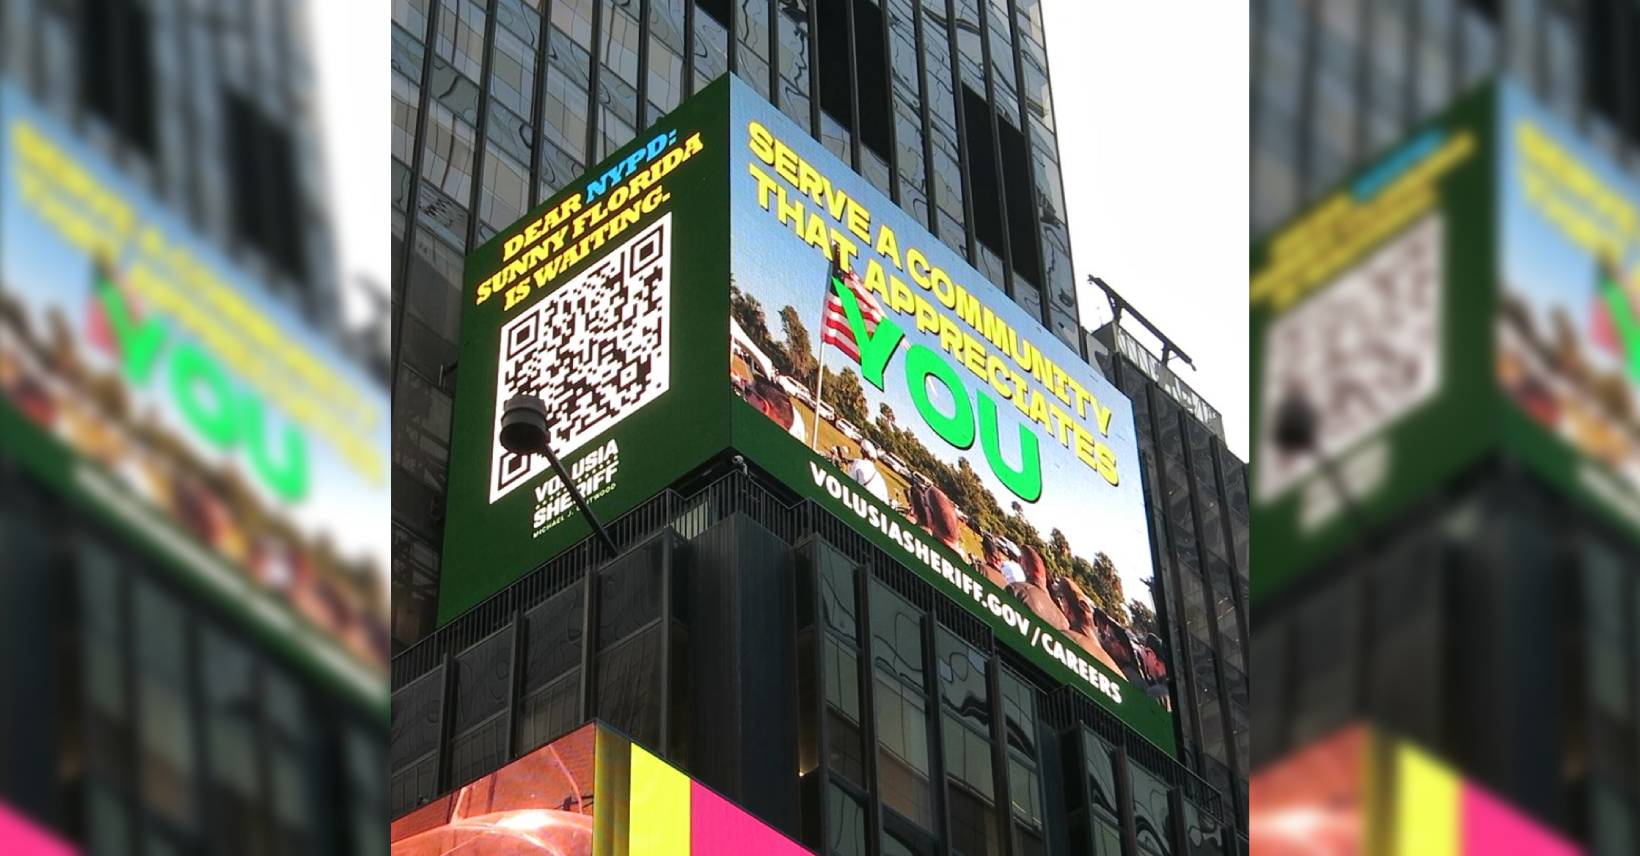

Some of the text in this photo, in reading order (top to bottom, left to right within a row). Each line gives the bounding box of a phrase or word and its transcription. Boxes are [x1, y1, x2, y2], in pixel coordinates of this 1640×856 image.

[476, 132, 704, 305] SUNNY FLORIDA
[503, 129, 677, 262] DEAR NYPD:
[504, 185, 671, 311] IS WAITING.
[747, 121, 1112, 438] SERVE A COMMUNITY
[748, 164, 858, 273] THAT
[864, 259, 1120, 487] APPRECIATES
[831, 276, 1043, 503] YOU
[534, 439, 619, 502] VOUSIA
